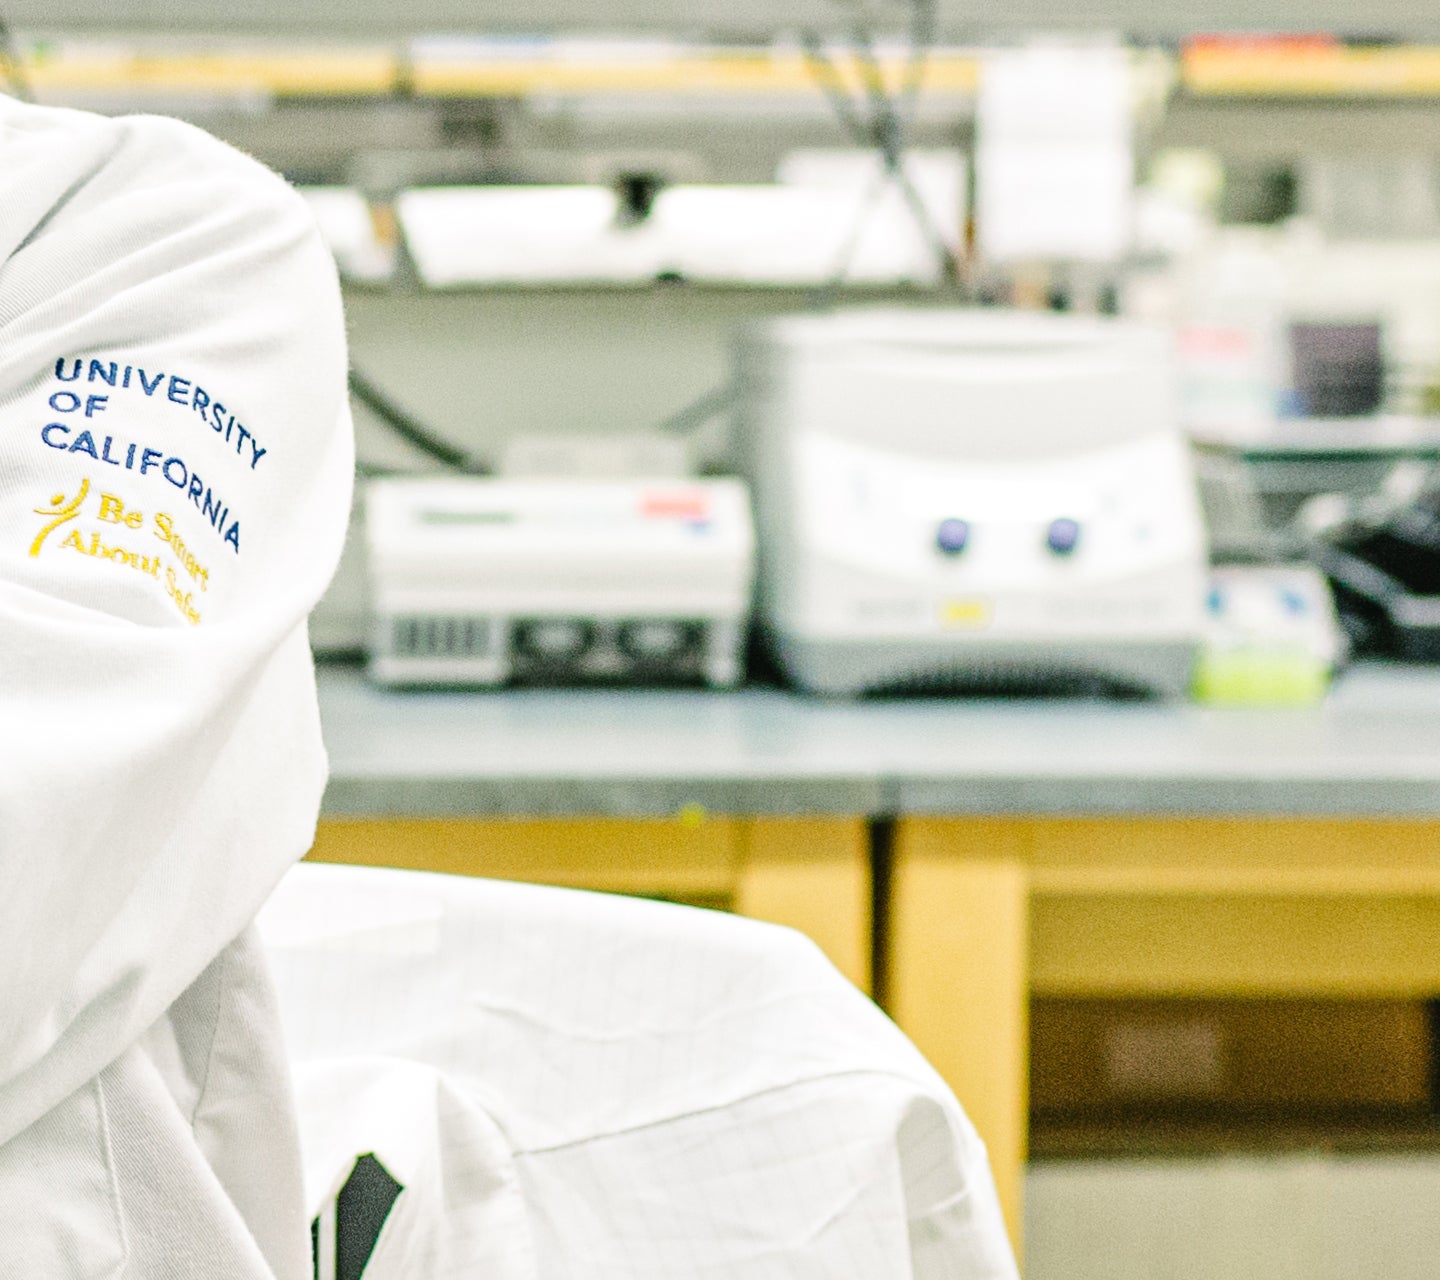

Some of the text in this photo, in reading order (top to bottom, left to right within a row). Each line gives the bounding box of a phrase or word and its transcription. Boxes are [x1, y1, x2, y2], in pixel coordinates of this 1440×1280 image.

[49, 392, 109, 418] OF
[55, 357, 267, 469] UNIVERSITY
[41, 423, 240, 553] CALIFORNIA
[60, 528, 161, 578] About
[97, 492, 209, 591] Be Smart
